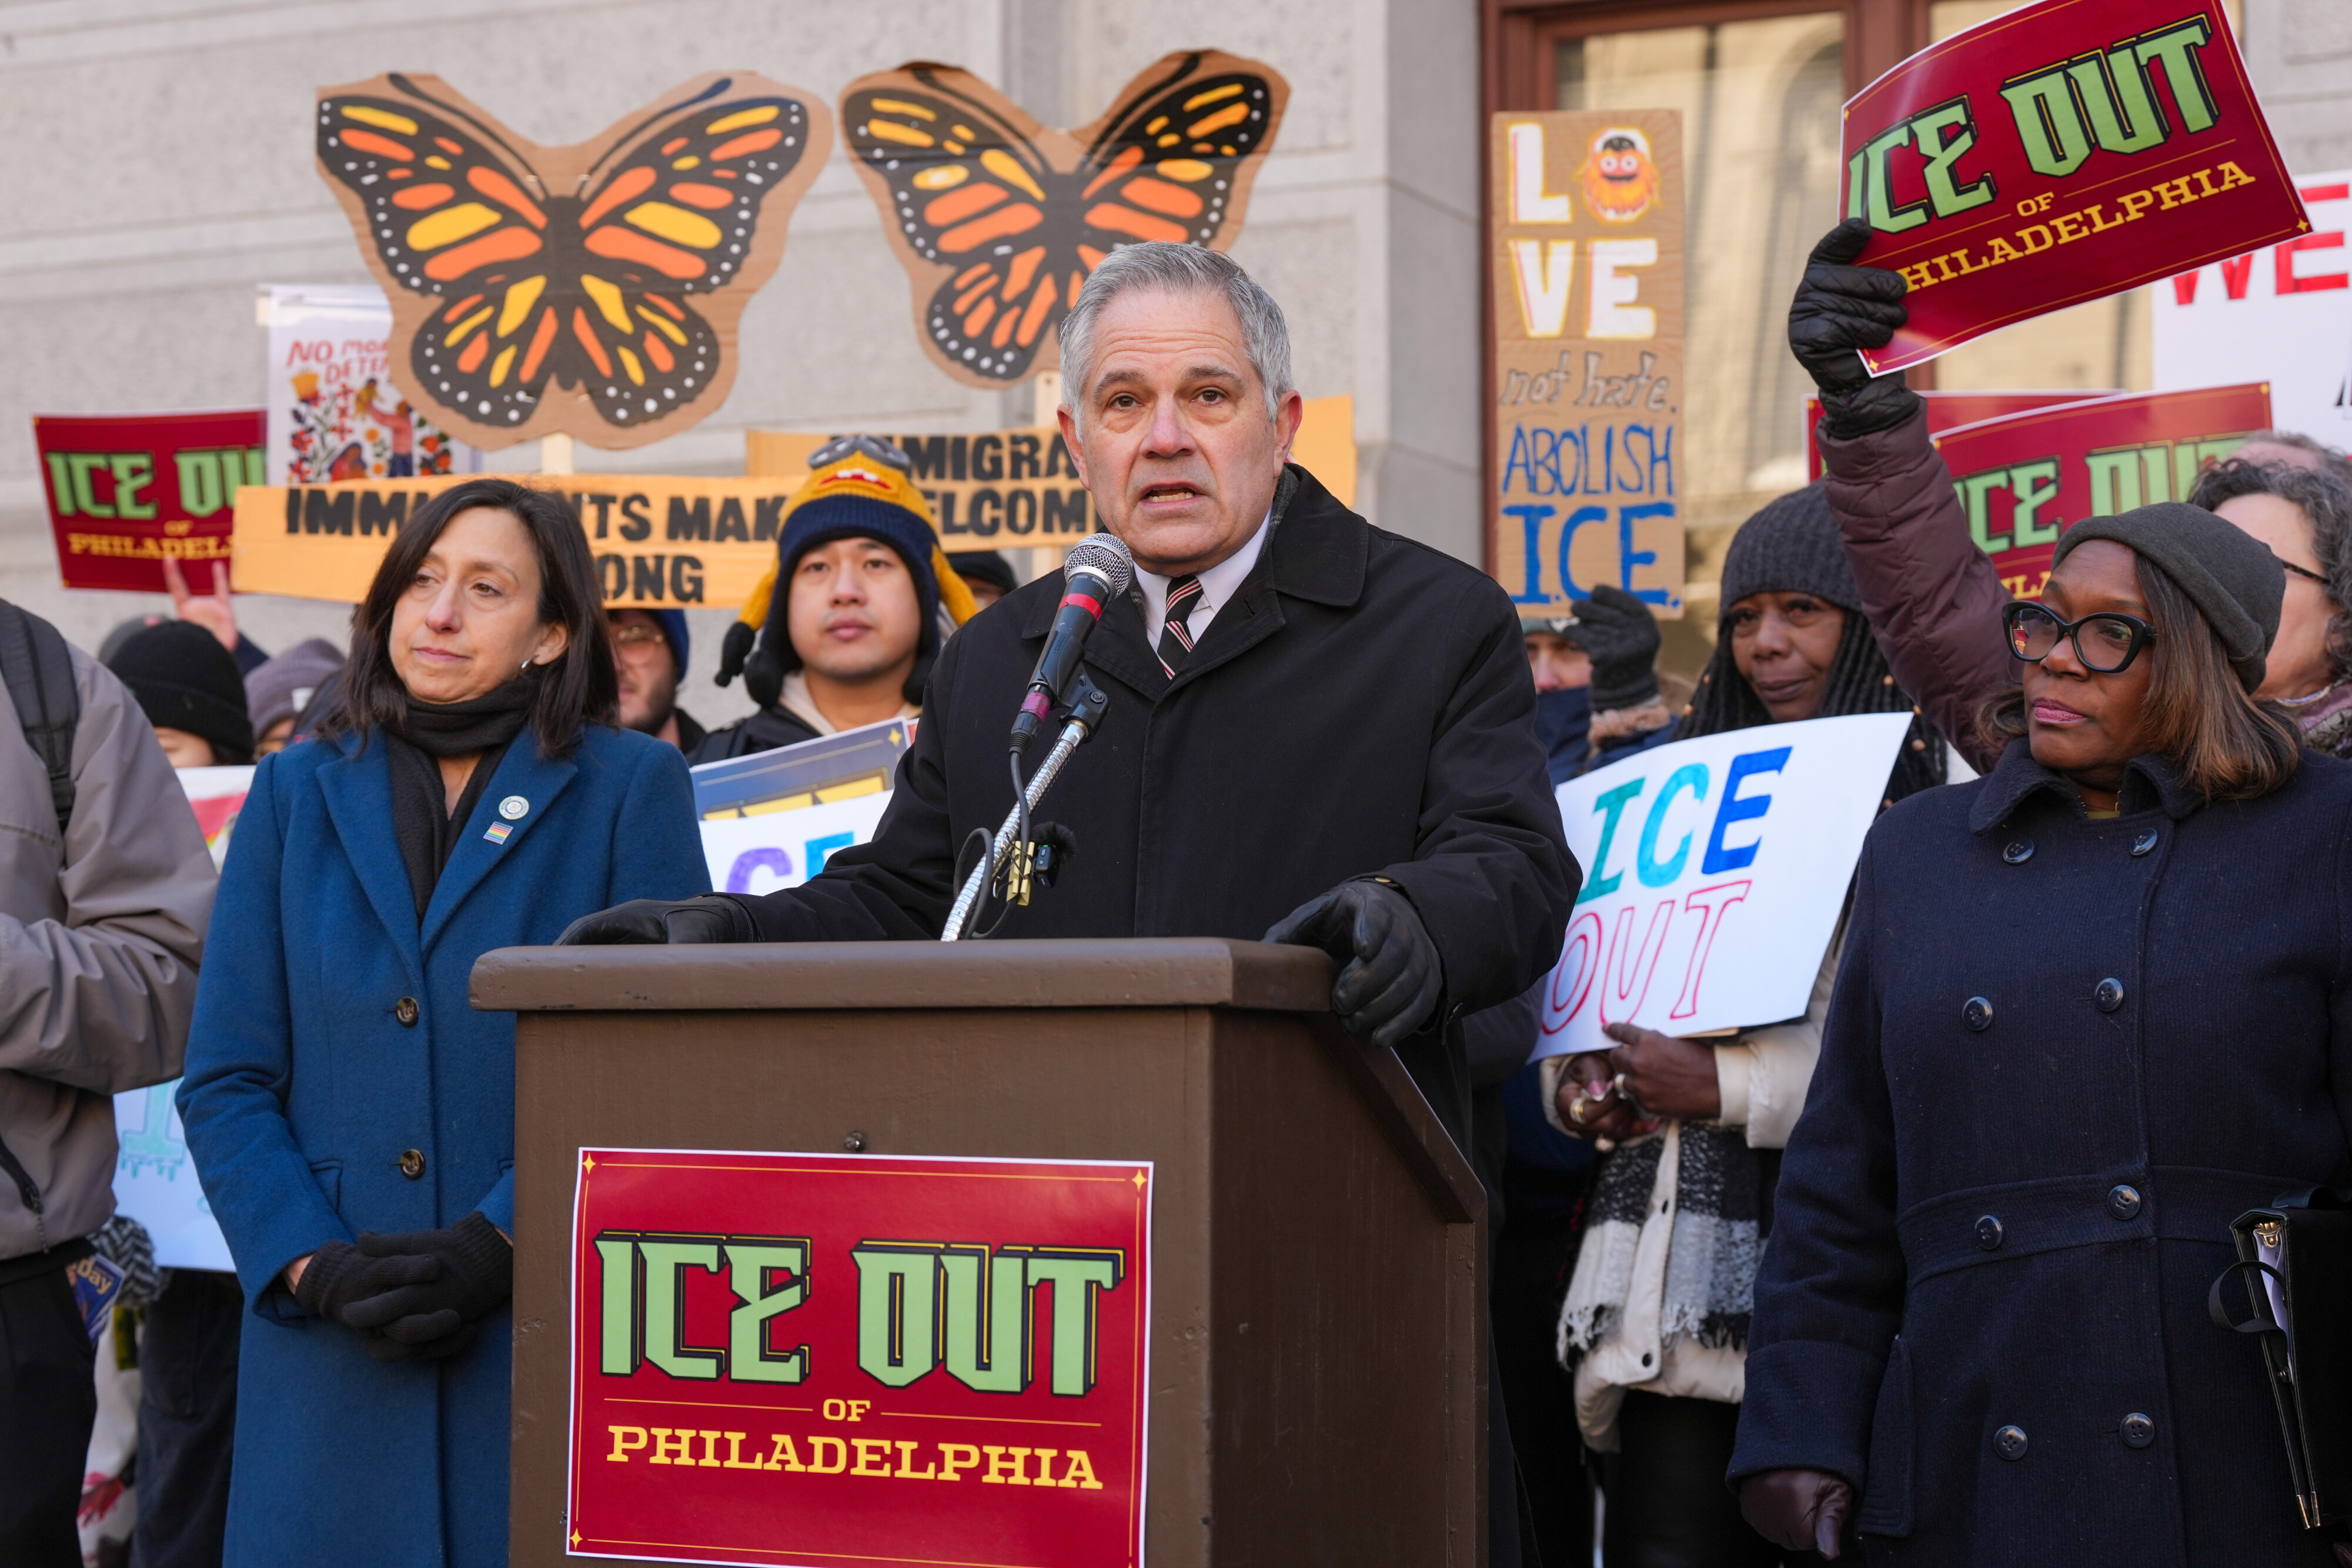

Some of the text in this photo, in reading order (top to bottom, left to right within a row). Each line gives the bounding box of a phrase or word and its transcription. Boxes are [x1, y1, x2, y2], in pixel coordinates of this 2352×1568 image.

[1847, 13, 2219, 233] ICE OUT
[1896, 161, 2256, 293] HILADELPHIA
[2016, 192, 2054, 217] OF
[287, 339, 332, 368] NO
[1500, 350, 1571, 406] not
[47, 446, 266, 520] ICE OU
[1502, 422, 1675, 497] ABOLISH
[66, 533, 233, 560] PHILADEL
[163, 520, 193, 536] OF
[667, 495, 789, 542] MAK
[1091, 577, 1110, 594] SHURE
[1575, 745, 1793, 906] ICE
[1541, 880, 1752, 1035] OUT
[593, 1229, 1126, 1397] ICE OUT
[822, 1399, 871, 1422] OF
[606, 1425, 1104, 1490] PHILADELPHIA
